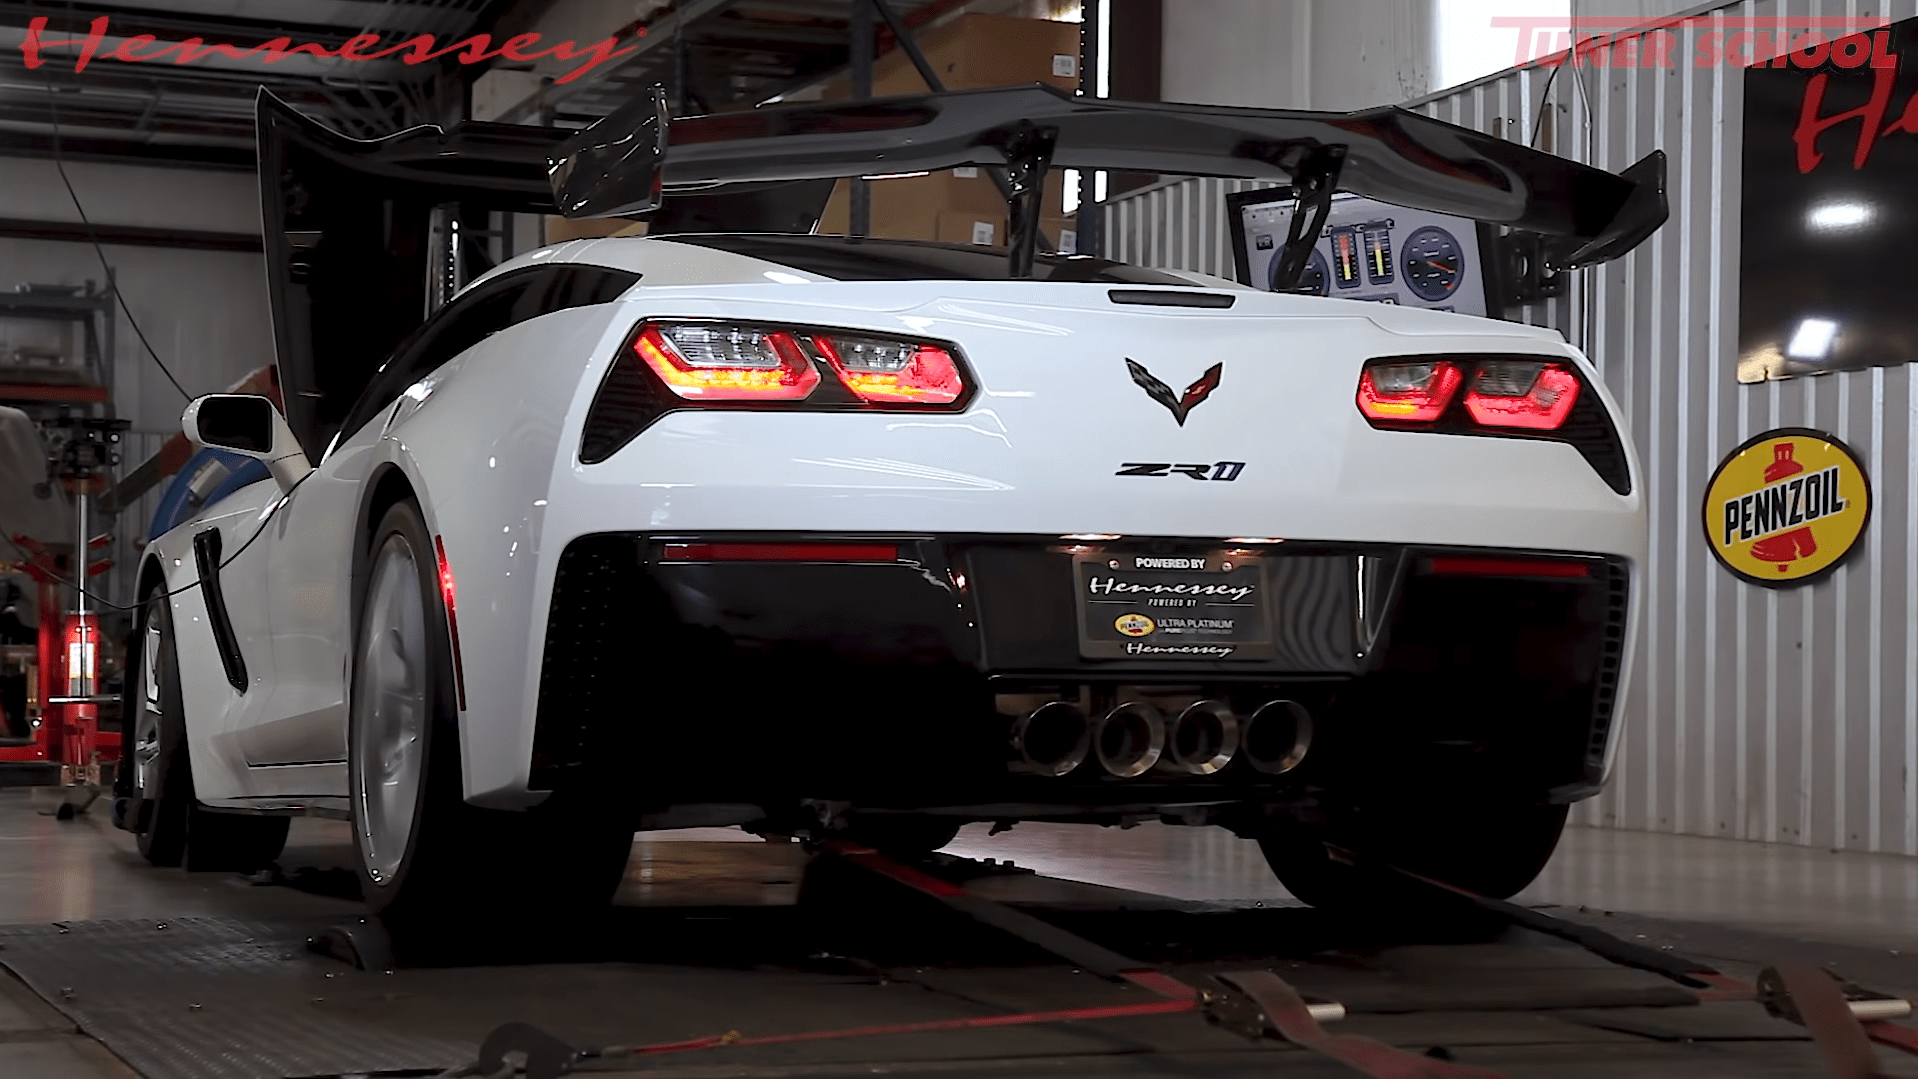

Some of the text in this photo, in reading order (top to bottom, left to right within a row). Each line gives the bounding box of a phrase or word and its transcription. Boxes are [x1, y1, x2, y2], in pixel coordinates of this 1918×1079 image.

[1114, 461, 1246, 482] ZR1
[1724, 466, 1845, 547] PENNZOIL
[1135, 557, 1206, 570] POWERED BY
[1089, 577, 1255, 601] Hennessey
[1147, 598, 1197, 607] POWERED BY
[1156, 618, 1185, 628] ULTRA
[1187, 619, 1234, 629] PLATINUM
[1126, 642, 1234, 658] Hennessey
